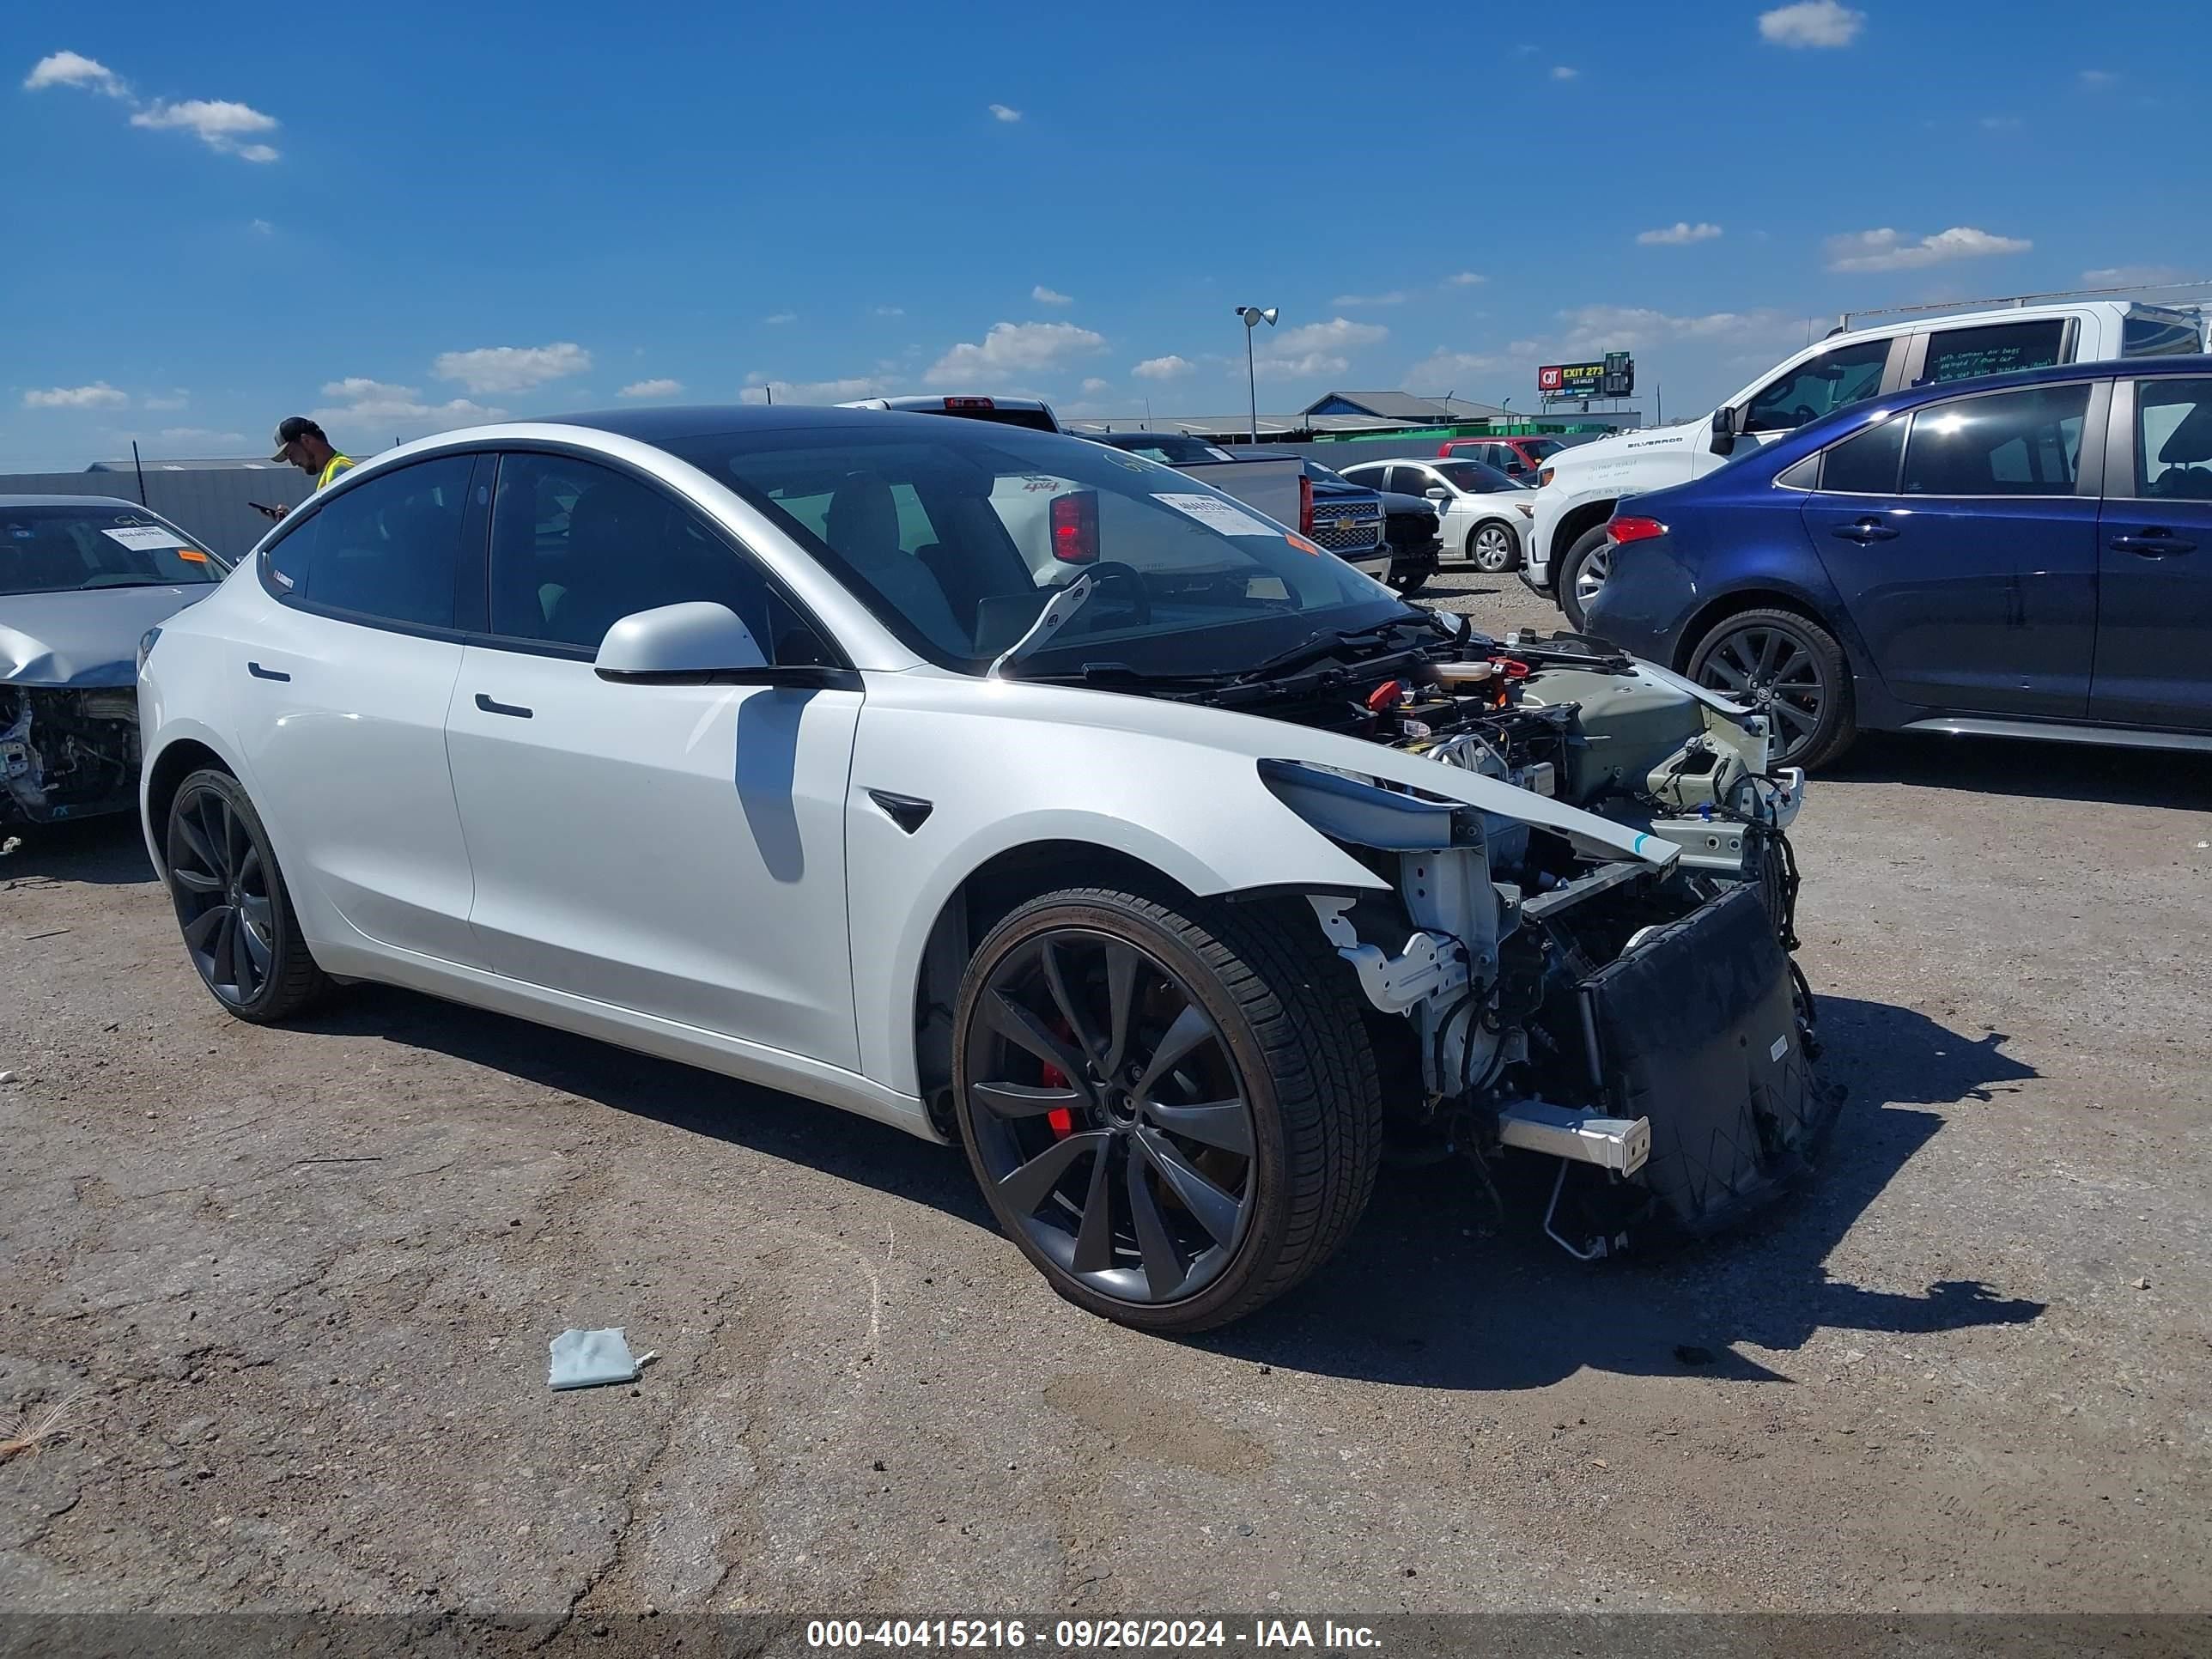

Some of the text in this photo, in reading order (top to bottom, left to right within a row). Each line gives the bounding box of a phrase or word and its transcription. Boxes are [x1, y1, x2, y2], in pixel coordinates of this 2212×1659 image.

[1542, 371, 1559, 385] QT
[1563, 366, 1604, 378] EXIT 273
[1627, 437, 1683, 447] SILVERADO
